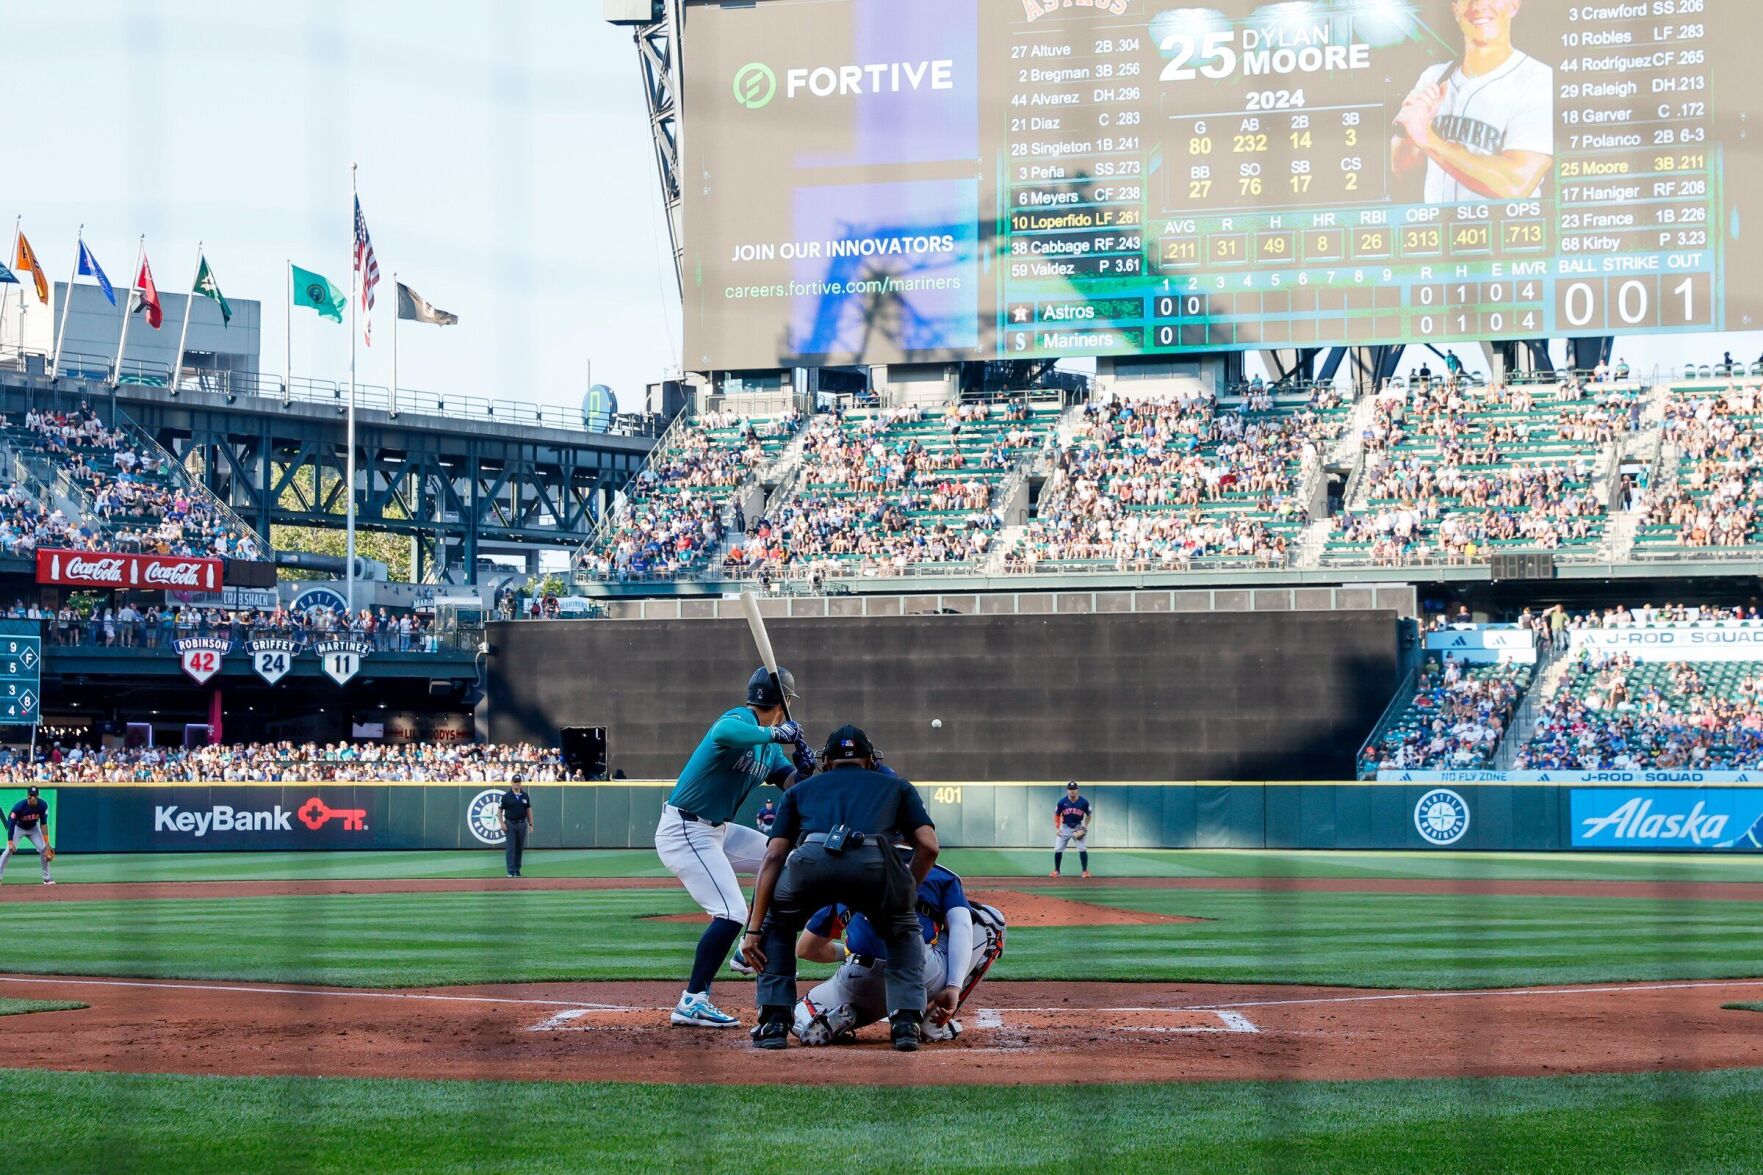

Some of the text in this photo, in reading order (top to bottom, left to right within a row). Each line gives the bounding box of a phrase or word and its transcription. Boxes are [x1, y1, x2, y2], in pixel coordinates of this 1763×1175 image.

[1569, 8, 1578, 21] 3
[1582, 3, 1647, 20] Crawford
[1653, 2, 1674, 15] SS
[1243, 25, 1329, 49] DYLAN
[1561, 24, 1704, 46] 10 Robles LF .283
[1011, 38, 1140, 59] 27 Altuve 2B .304
[1159, 31, 1236, 81] 25
[1243, 43, 1370, 75] MOORE
[1560, 60, 1578, 72] 44
[1653, 52, 1675, 66] CF
[1677, 50, 1704, 65] .265
[787, 60, 953, 98] FORTIVE
[1019, 62, 1140, 83] 2 Bregman 3B .256
[1011, 87, 1140, 107] 44 Alvarez DH .296
[1560, 76, 1704, 98] 29 Raleigh DH .213
[1245, 89, 1305, 110] 2024
[1011, 118, 1026, 131] 21
[1116, 112, 1140, 125] .283
[1240, 112, 1360, 132] AB 2B 3B
[1562, 102, 1704, 124] 18 Garver .172
[1011, 137, 1139, 156] 28 Singleton 1B .241
[1189, 131, 1312, 155] 80 232 14
[1570, 128, 1704, 149] 7 Polanco 2B 6-3
[1019, 161, 1140, 179] 3 Peña SS .273
[1191, 157, 1362, 179] BB SO SB CS
[1561, 155, 1704, 176] 25 Moore 3B .211
[1019, 186, 1140, 206] 6 Meyers CF .238
[1189, 175, 1312, 199] 27 76 17
[1562, 181, 1705, 202] 17 Haniger RF .208
[1012, 211, 1139, 229] 10 Loperfido LF .261
[1164, 203, 1540, 234] AVG HR RBI OBP SLG OPS
[1561, 208, 1706, 228] 23 France 1B .226
[732, 235, 954, 262] JOIN OUR INNOVATORS
[1012, 236, 1140, 256] 38 Cabbage RF .243
[1164, 226, 1541, 259] .211 31 49 26 .313 .401 .713
[1562, 231, 1705, 251] 68 Kirby P 3.23
[1012, 259, 1139, 277] 59 Valdez P 3.61
[1559, 253, 1702, 273] BALL STRIKE OUT
[725, 275, 961, 299] careers.fortive.com/mariners
[1565, 277, 1692, 325] 0 0 1
[1043, 306, 1094, 320] Astros
[1043, 334, 1114, 349] Mariners
[66, 557, 199, 586] Coca-Cola Coca-Cola
[244, 594, 268, 606] SHACK
[10, 642, 17, 653] 9
[179, 638, 228, 650] ROBINSON
[252, 640, 295, 650] GRIFFEY
[318, 641, 368, 654] MARTINEZ
[1606, 632, 1675, 644] J-ROD
[9, 662, 17, 673] 5
[190, 653, 214, 672] 42
[262, 654, 285, 672] 24
[335, 655, 350, 673] 11
[9, 685, 16, 696] 3
[8, 706, 15, 716] 4
[1442, 772, 1507, 781] NO FLY ZONE
[1581, 773, 1704, 782] J-ROD SQUAD
[934, 787, 962, 803] 401
[155, 805, 292, 837] KeyBank
[1581, 797, 1729, 844] Alaska
